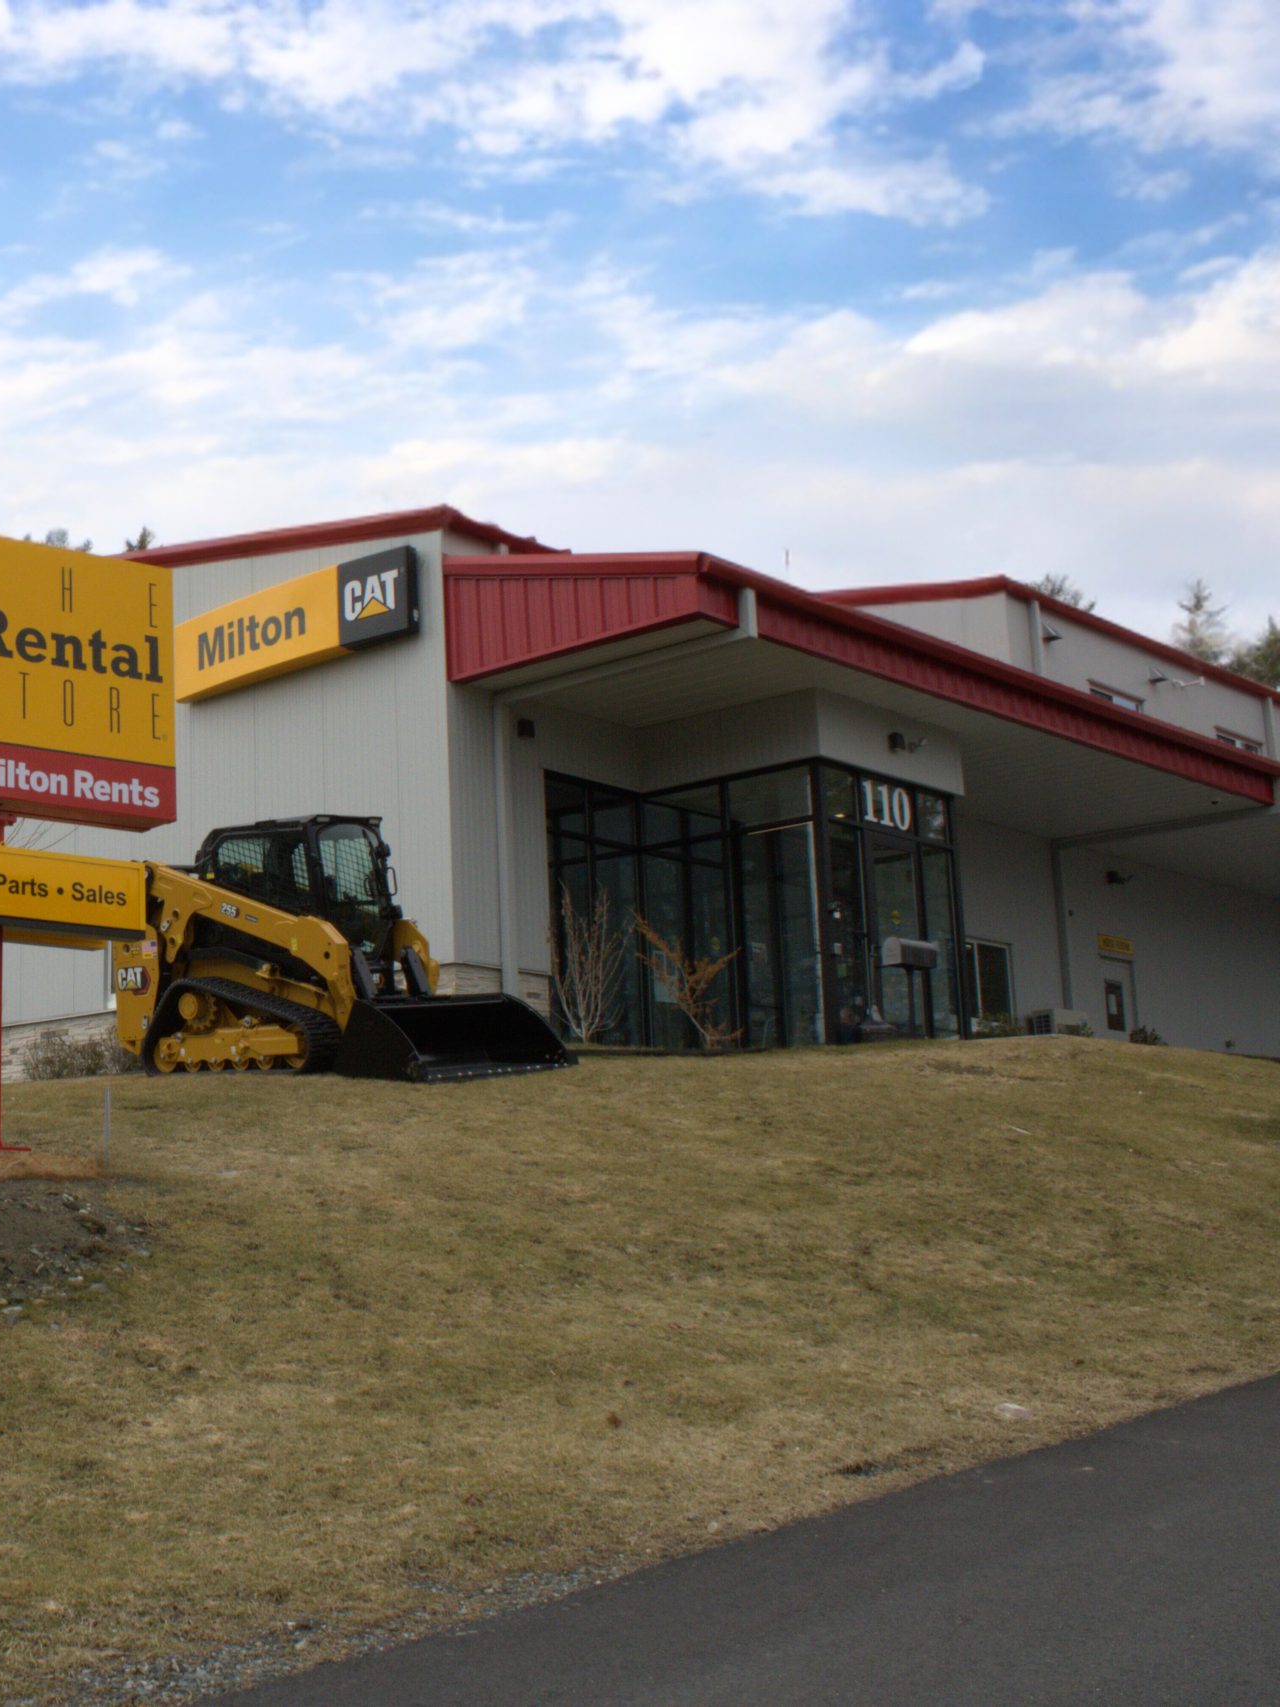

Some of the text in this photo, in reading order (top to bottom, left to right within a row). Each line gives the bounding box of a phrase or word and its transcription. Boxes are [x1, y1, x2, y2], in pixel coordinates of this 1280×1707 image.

[197, 568, 399, 671] Milton CAT
[73, 769, 160, 808] Rents
[862, 779, 911, 832] 110
[71, 882, 127, 907] Sales
[221, 903, 237, 918] 255
[117, 966, 143, 991] CAT
